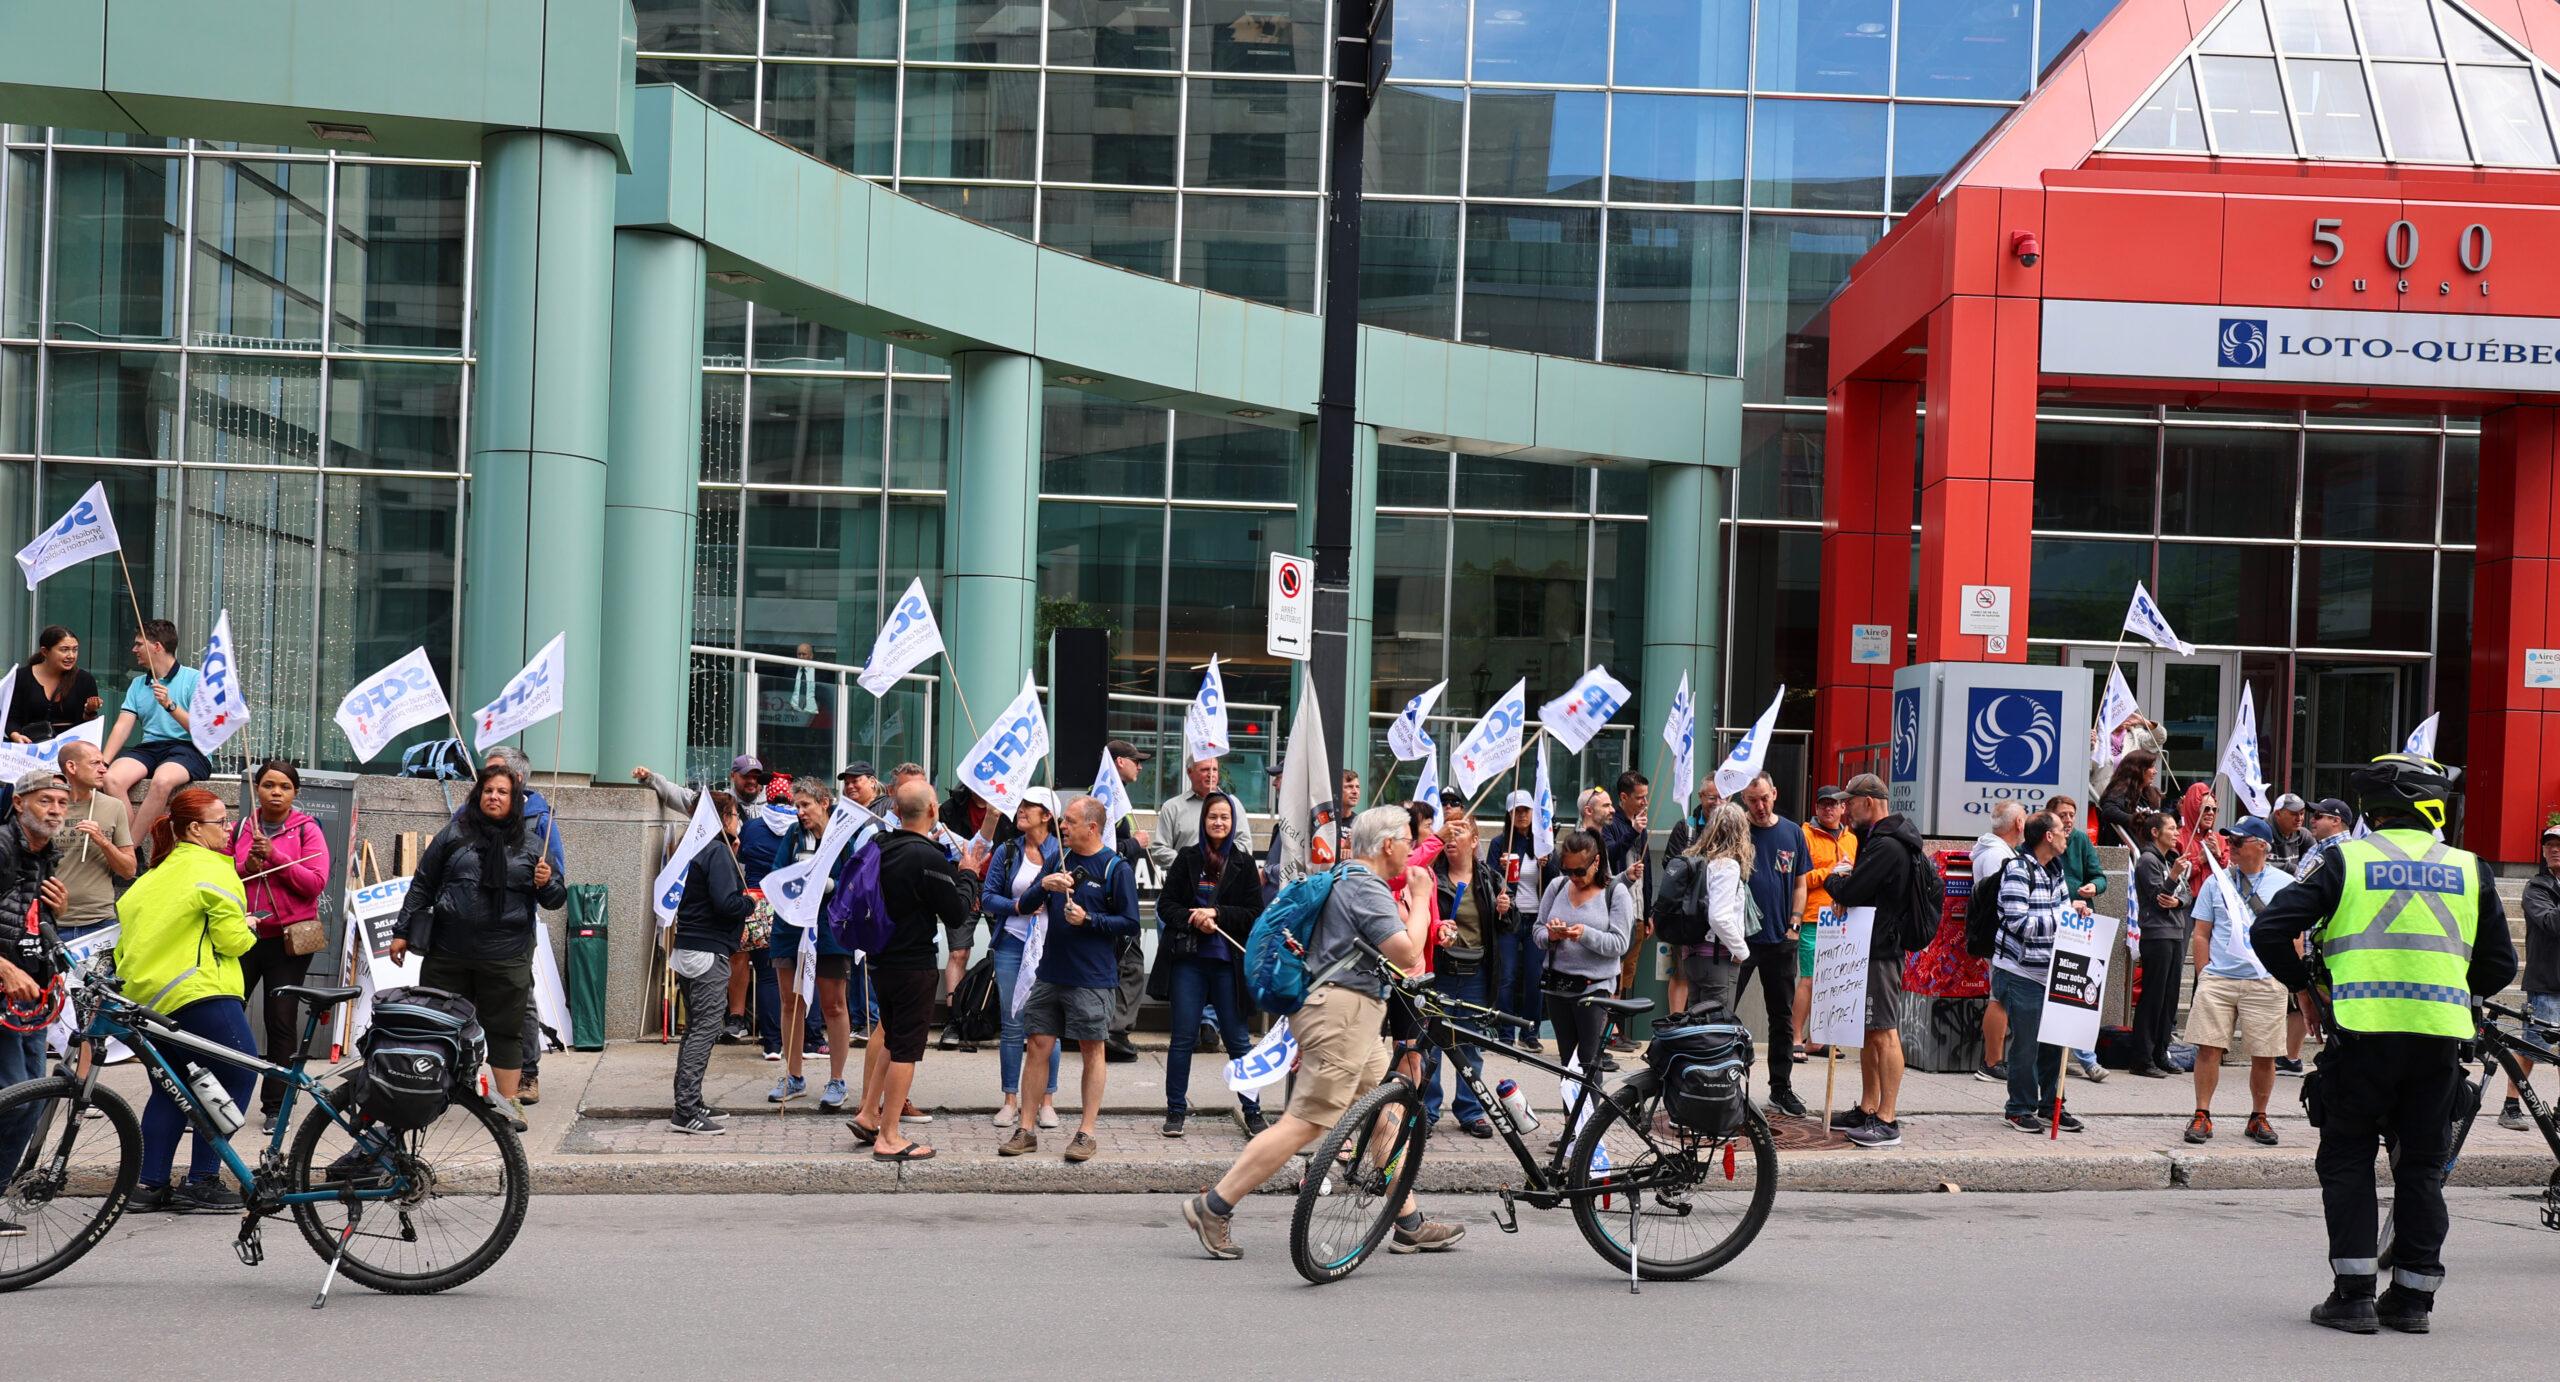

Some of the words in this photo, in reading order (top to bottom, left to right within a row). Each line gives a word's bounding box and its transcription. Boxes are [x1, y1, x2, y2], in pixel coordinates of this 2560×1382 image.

[2310, 217, 2493, 274] 500
[2310, 274, 2491, 297] ouest
[2279, 335, 2560, 366] LOTO-QUÉBE
[1981, 787, 2045, 801] LOTO
[306, 802, 336, 810] CANADA
[1963, 801, 2044, 815] QUBE
[2372, 864, 2459, 889] POLICE
[2058, 957, 2080, 970] Miser
[2056, 971, 2070, 980] sur
[2069, 973, 2088, 984] notre
[161, 1078, 193, 1113] SPVM
[1472, 1079, 1512, 1135] SPVM
[2524, 1090, 2546, 1118] SPVM
[1329, 1256, 1360, 1277] MAXXIS
